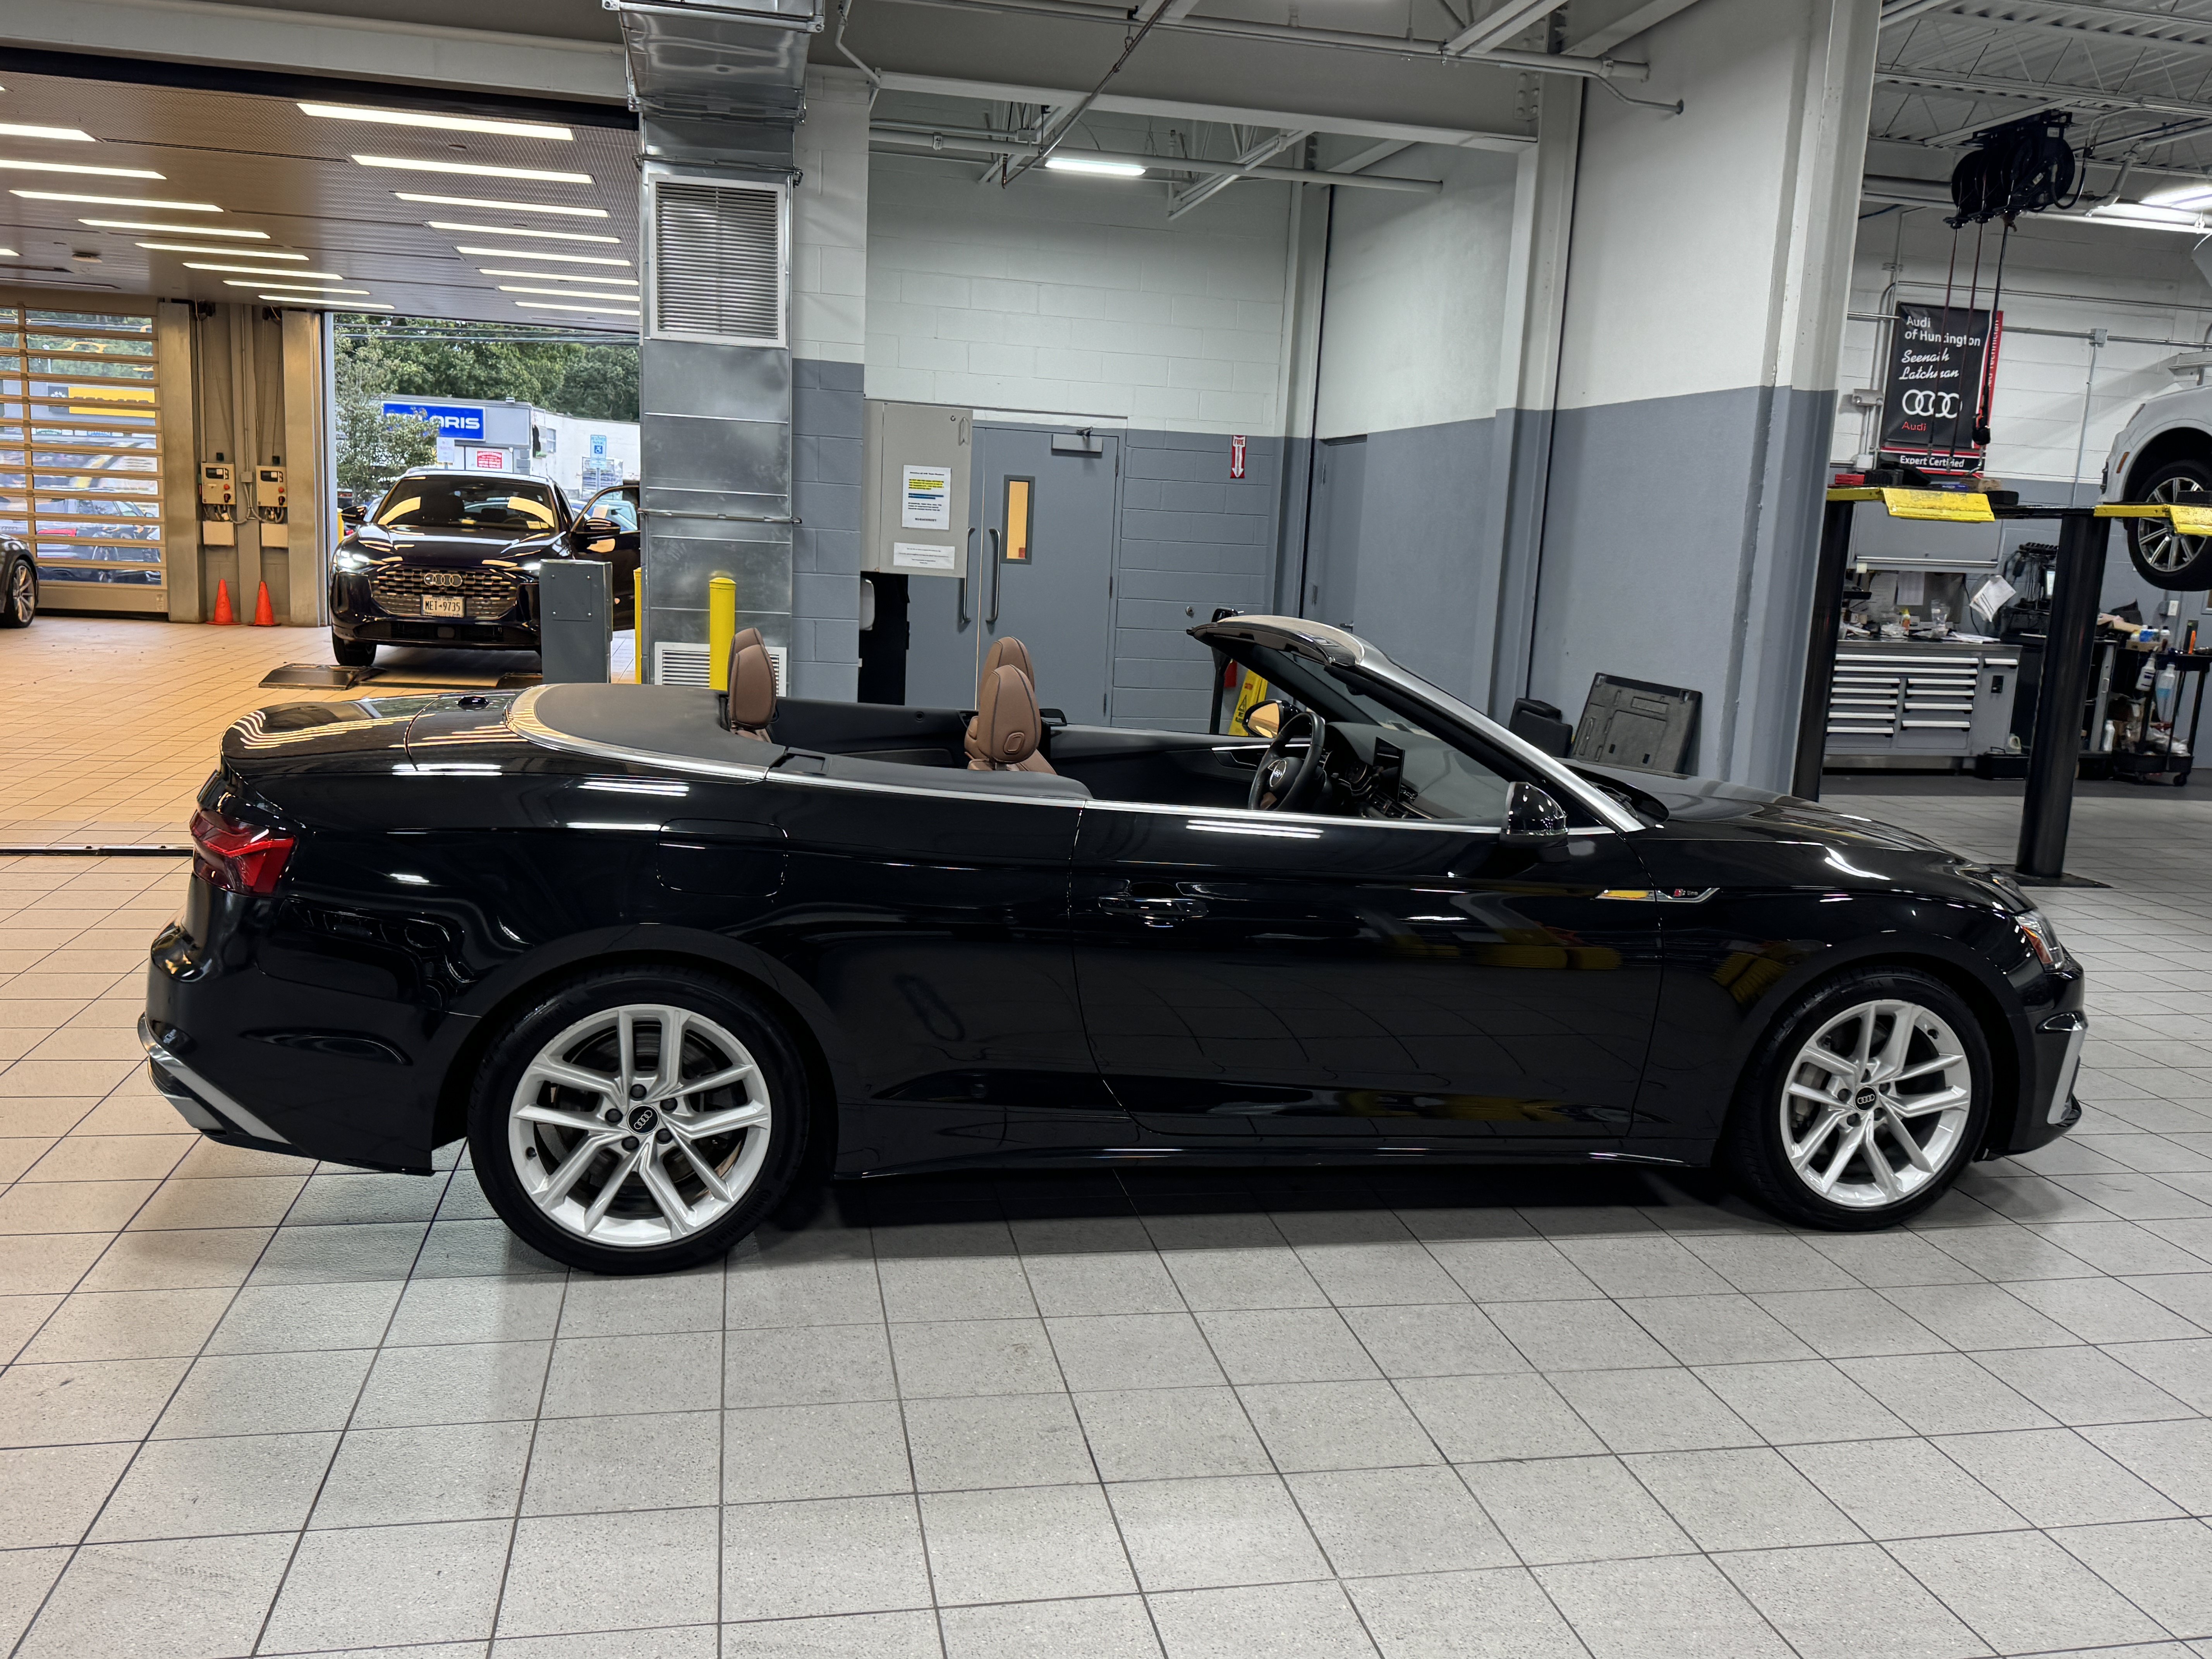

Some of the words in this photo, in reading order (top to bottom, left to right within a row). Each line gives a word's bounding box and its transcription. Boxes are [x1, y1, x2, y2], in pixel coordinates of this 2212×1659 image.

[1906, 316, 1930, 328] Audi
[1905, 328, 1918, 340] of
[1901, 347, 1949, 363] Seenah
[386, 413, 480, 429] ARIS
[1901, 421, 1927, 431] Audi
[1900, 455, 1927, 465] Expert
[1929, 457, 1965, 467] Certiied
[443, 601, 460, 611] 9735
